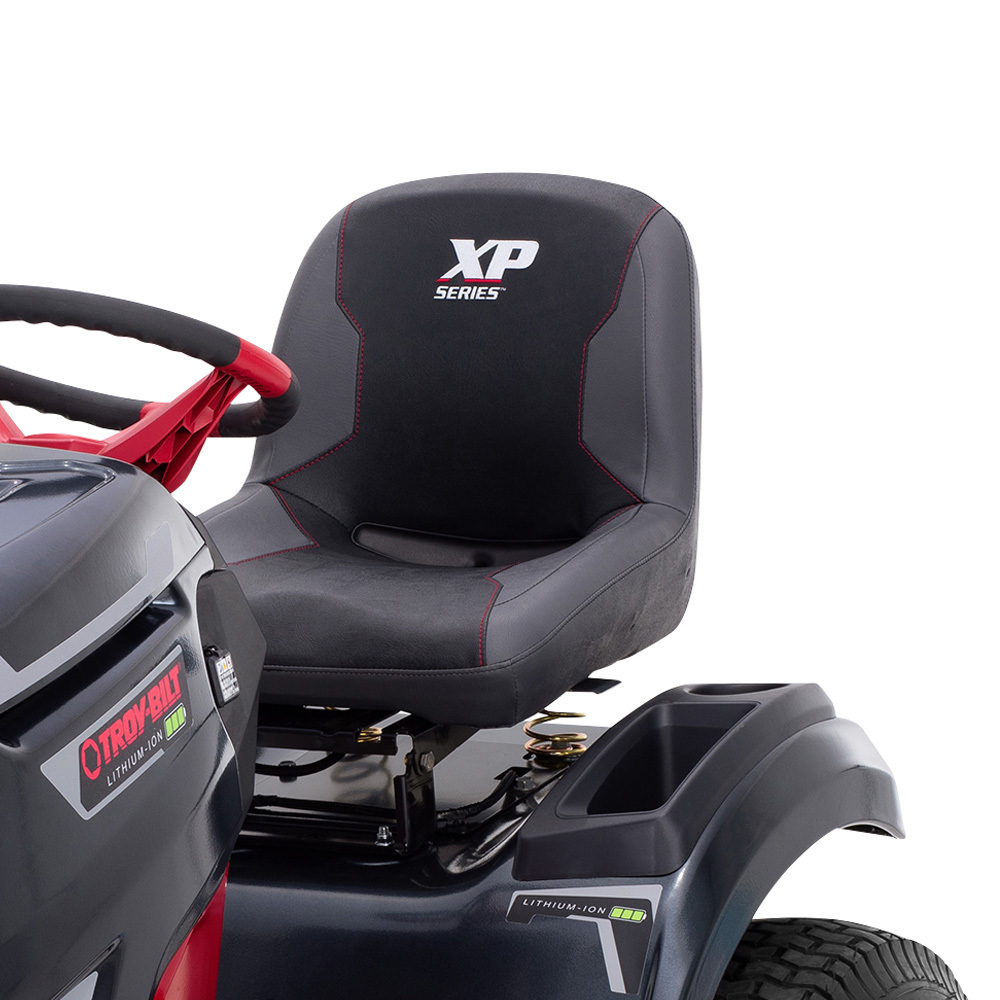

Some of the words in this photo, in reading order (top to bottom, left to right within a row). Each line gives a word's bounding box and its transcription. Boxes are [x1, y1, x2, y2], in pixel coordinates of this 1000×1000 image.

[440, 239, 540, 279] XP
[98, 664, 182, 765] TROY-BILT
[106, 730, 163, 787] LITHIUM-ION
[522, 898, 608, 915] LITHIUM-ION
